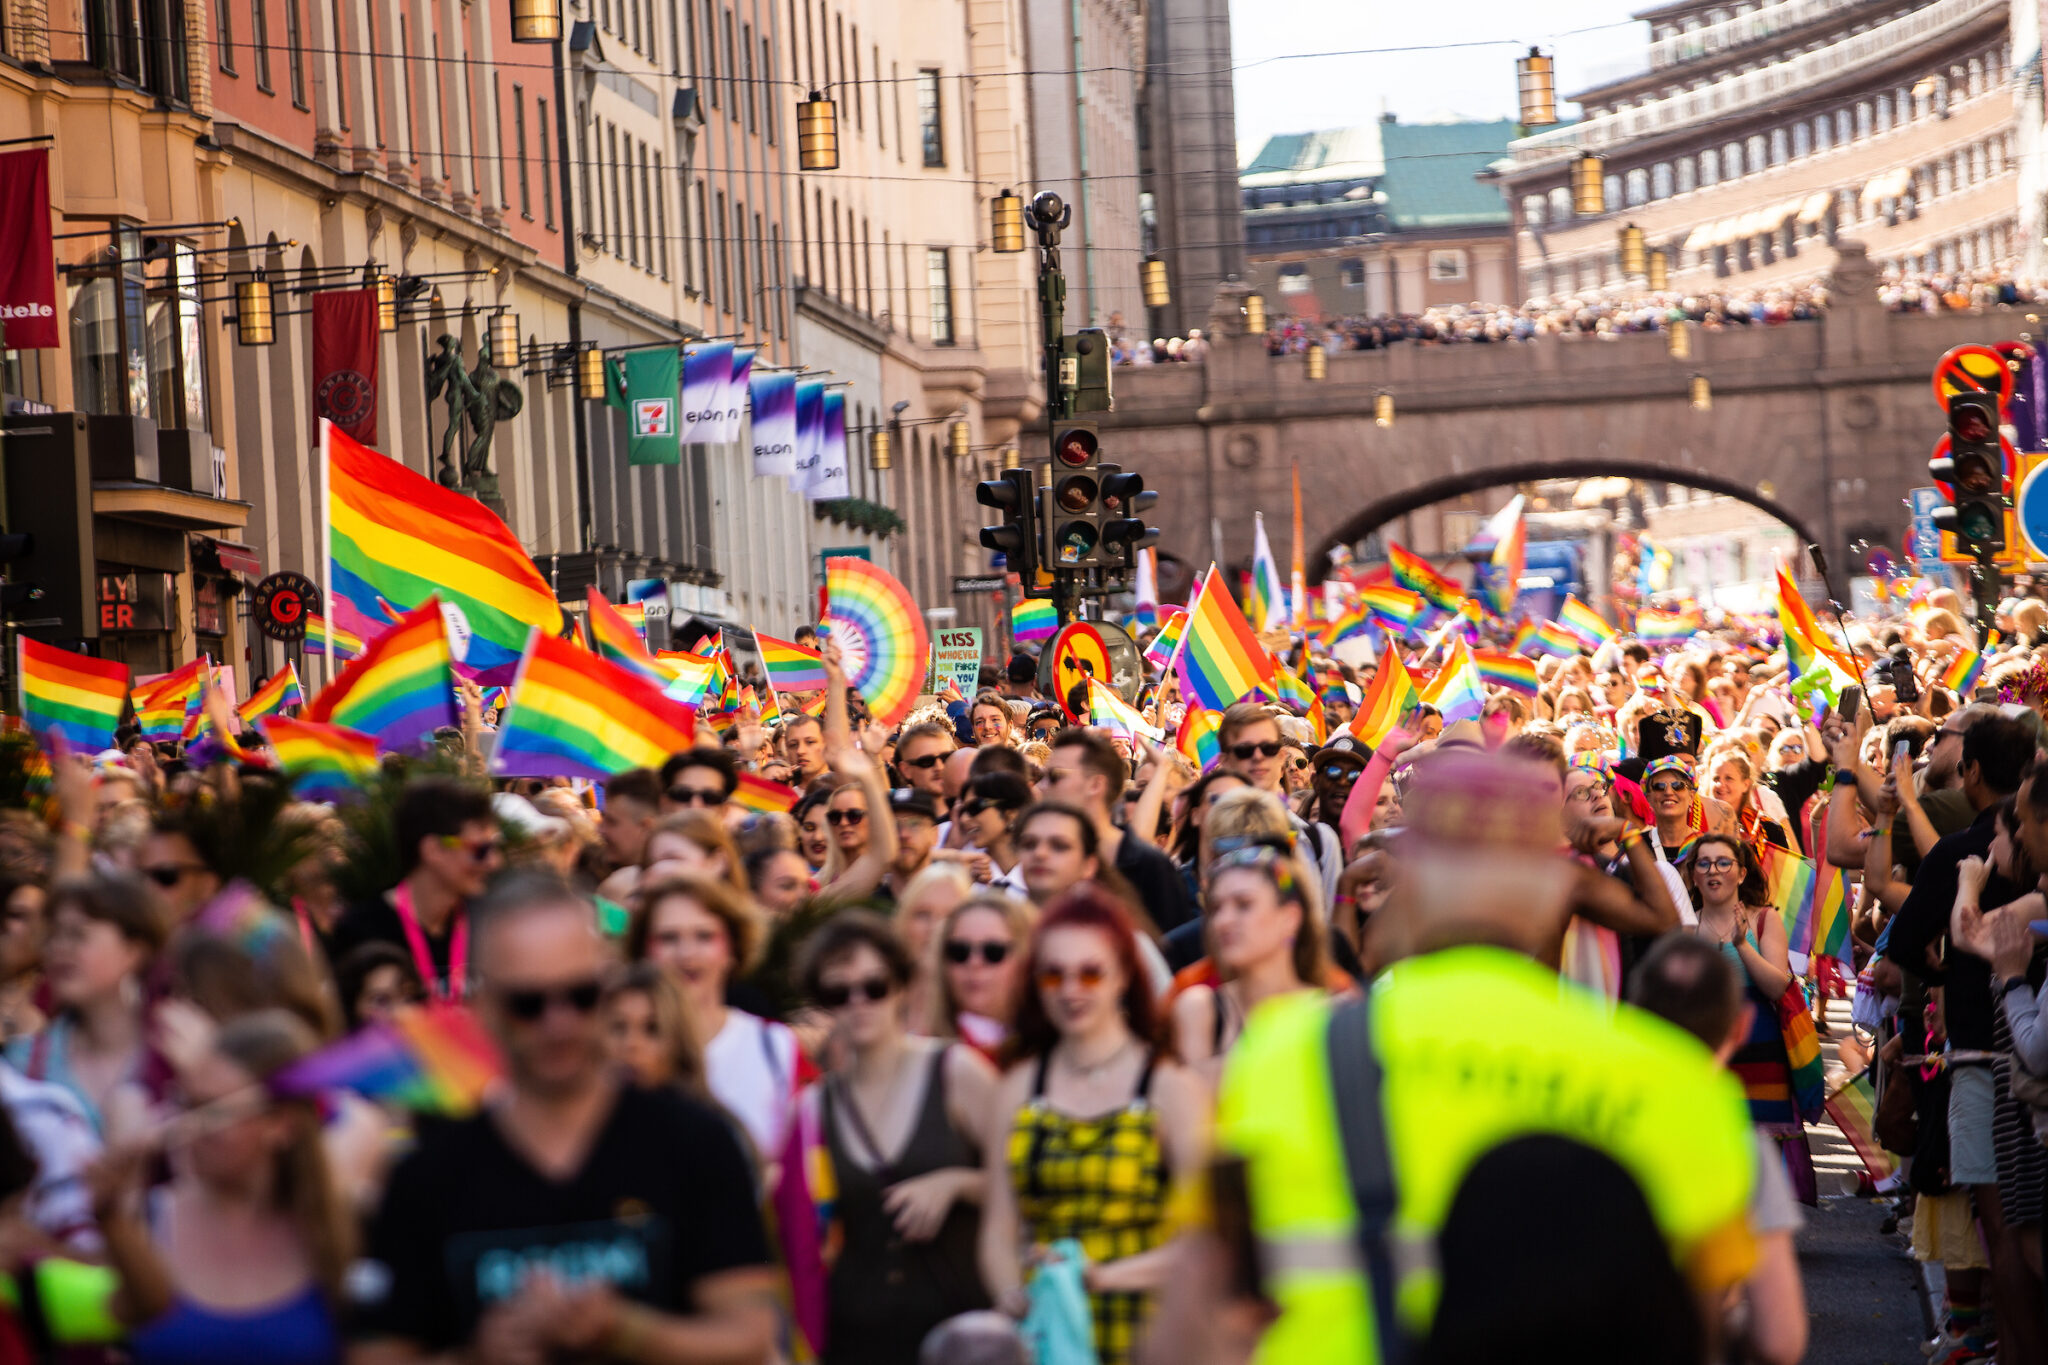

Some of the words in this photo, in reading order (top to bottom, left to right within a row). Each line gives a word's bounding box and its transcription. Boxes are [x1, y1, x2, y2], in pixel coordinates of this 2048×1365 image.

[0, 302, 53, 319] iele
[642, 405, 664, 435] 7
[97, 576, 127, 601] LY
[256, 575, 316, 604] GNARLY
[271, 589, 302, 624] G
[264, 620, 303, 638] BURGE
[940, 632, 975, 647] KISS
[938, 649, 979, 660] WHOEVER
[957, 673, 975, 683] YOU
